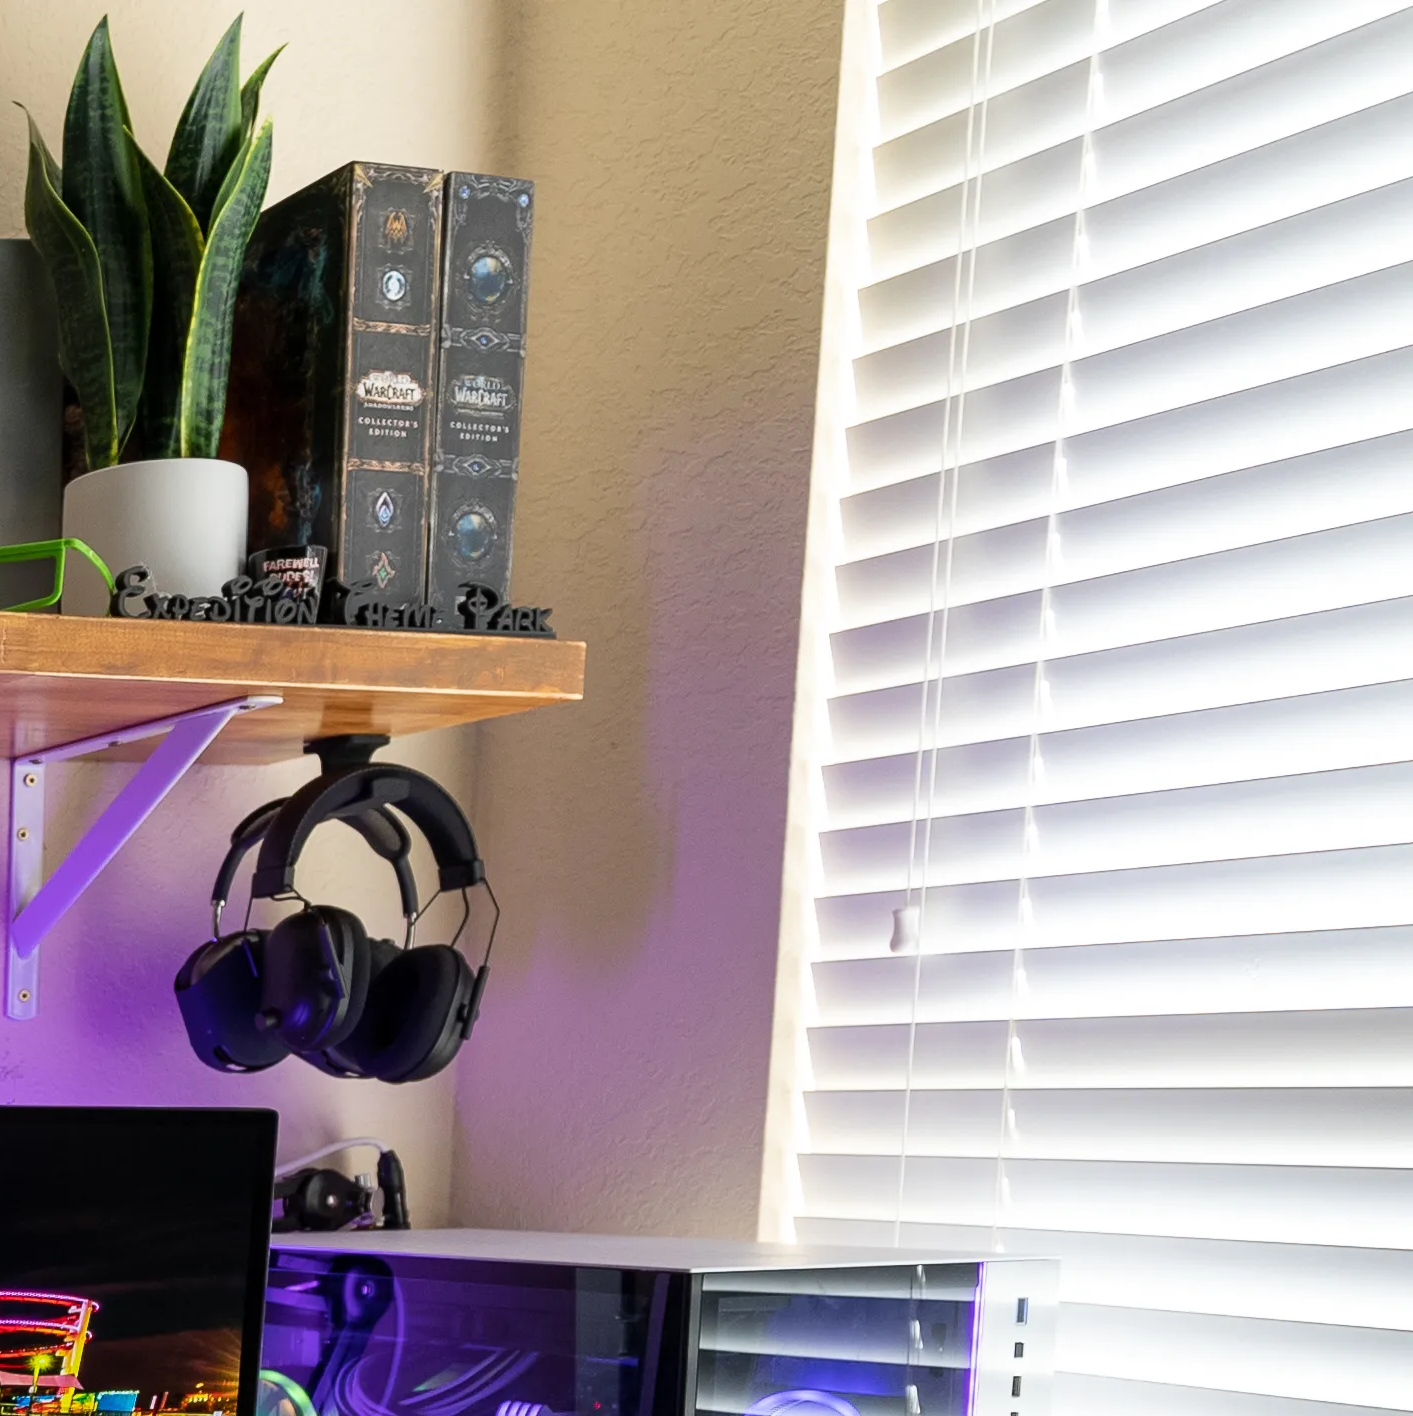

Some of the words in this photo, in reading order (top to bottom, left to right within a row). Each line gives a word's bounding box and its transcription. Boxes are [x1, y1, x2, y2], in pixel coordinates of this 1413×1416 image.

[358, 416, 419, 428] COLLECTOR'S
[450, 421, 510, 434] COLLECTOR'S
[368, 428, 407, 438] EDITION
[460, 433, 498, 442] EDITION
[263, 558, 319, 571] FAREWELL
